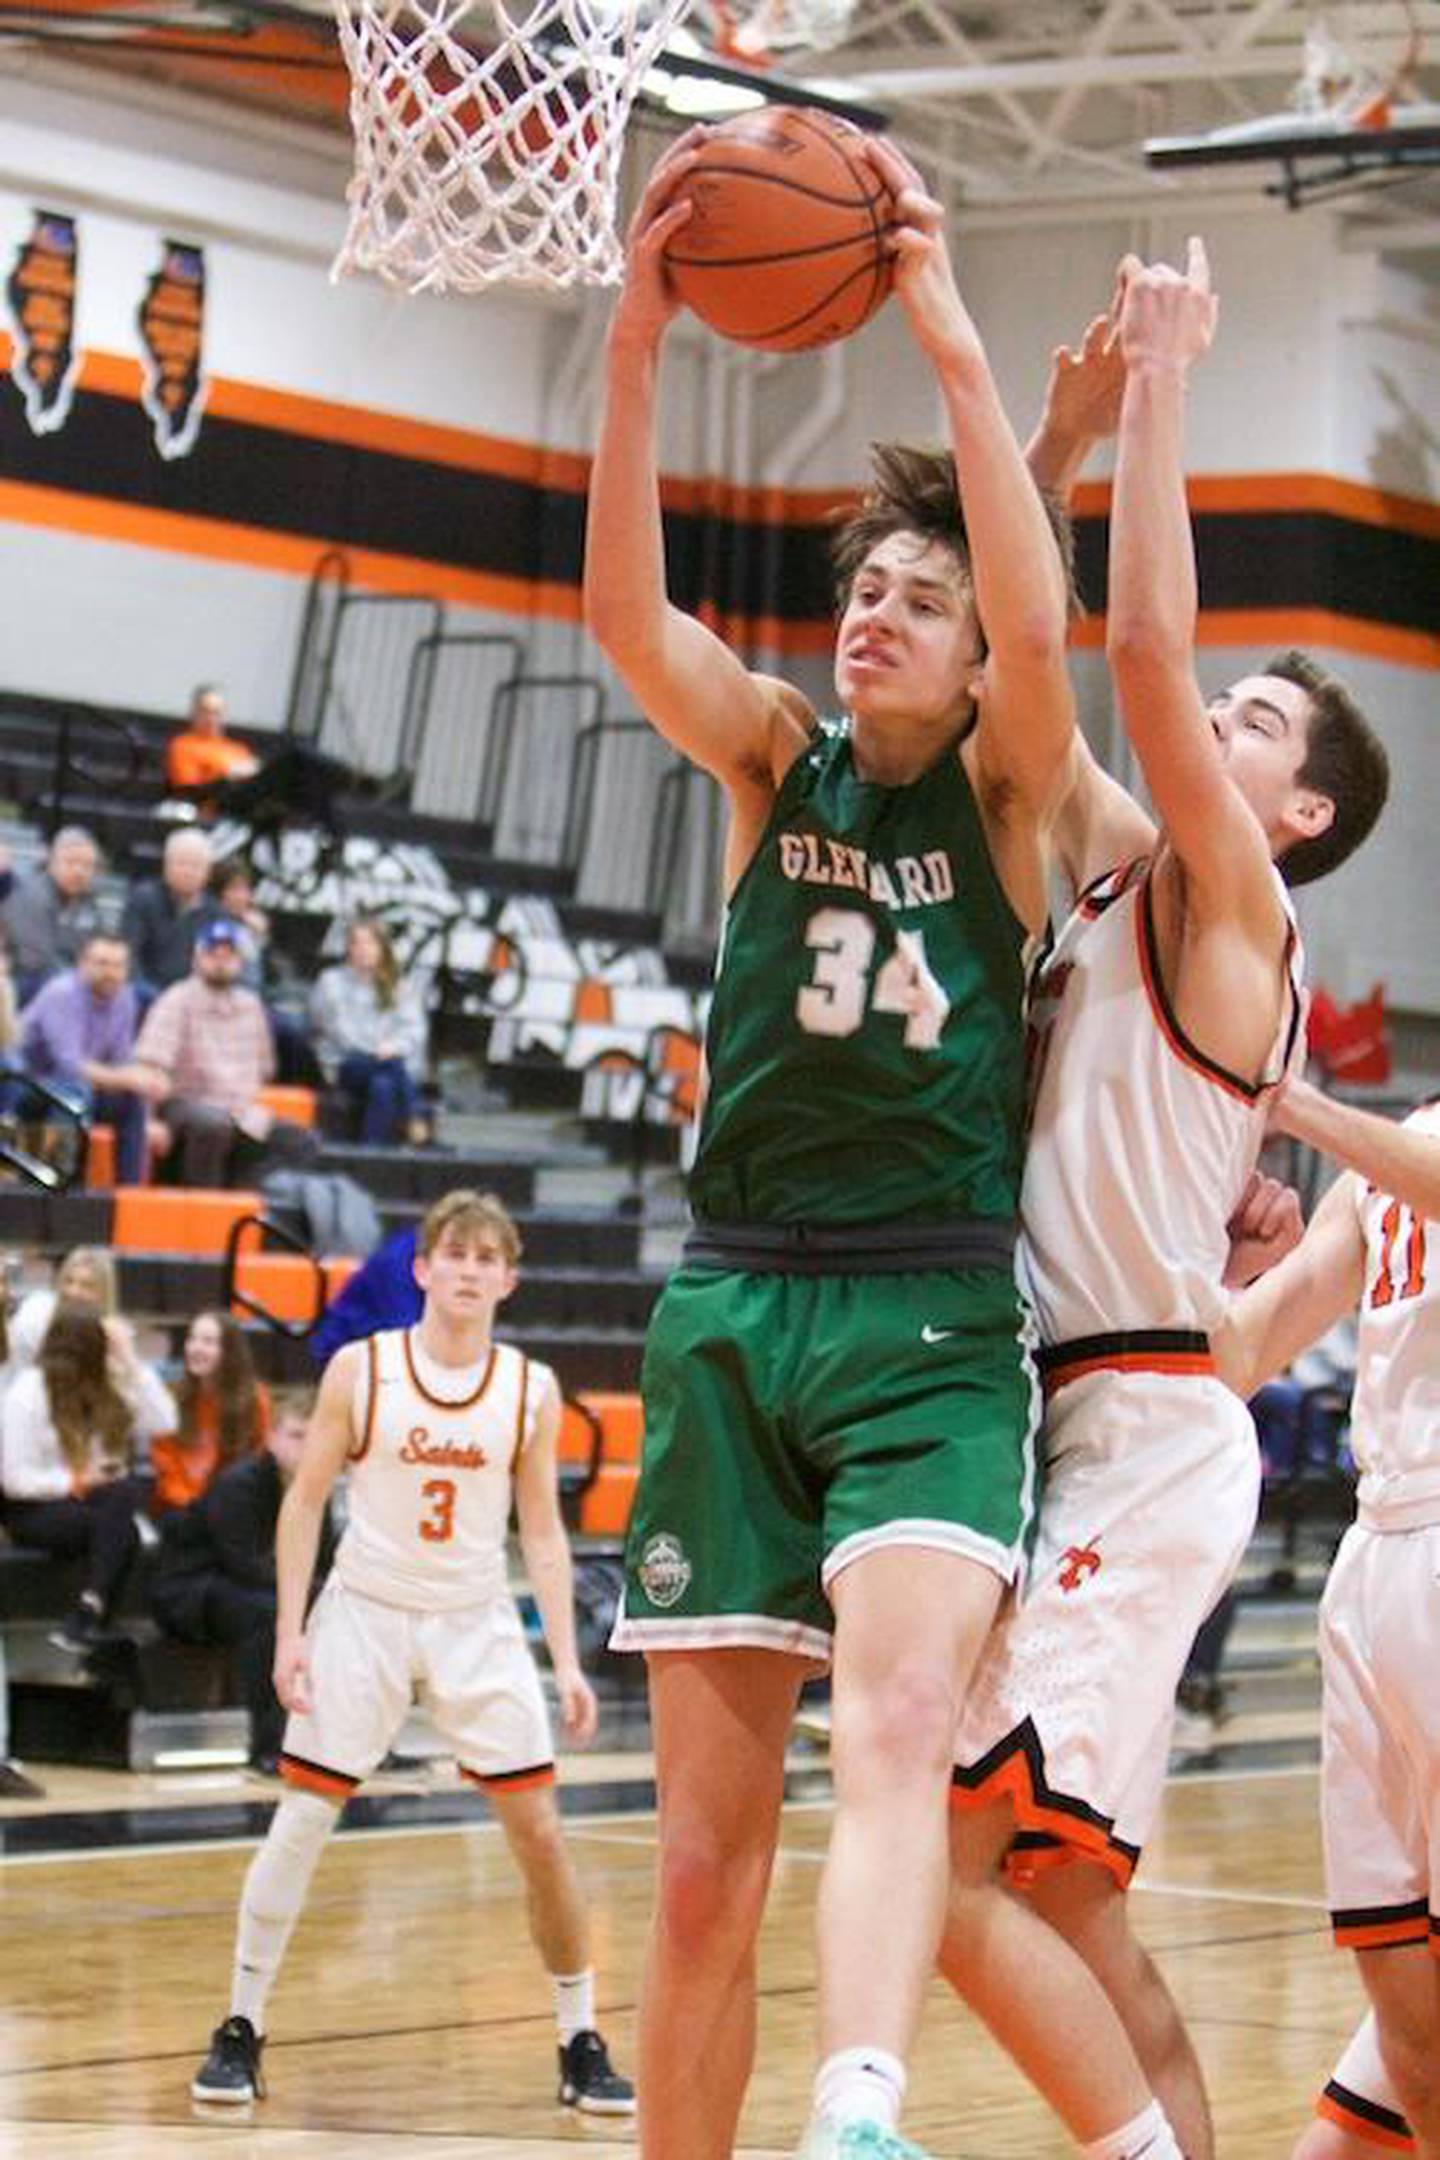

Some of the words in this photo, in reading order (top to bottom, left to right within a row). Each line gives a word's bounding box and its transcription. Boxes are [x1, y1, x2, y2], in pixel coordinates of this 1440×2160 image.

[796, 906, 951, 1049] 34
[1371, 1200, 1426, 1309] 11
[420, 1480, 456, 1542] 3
